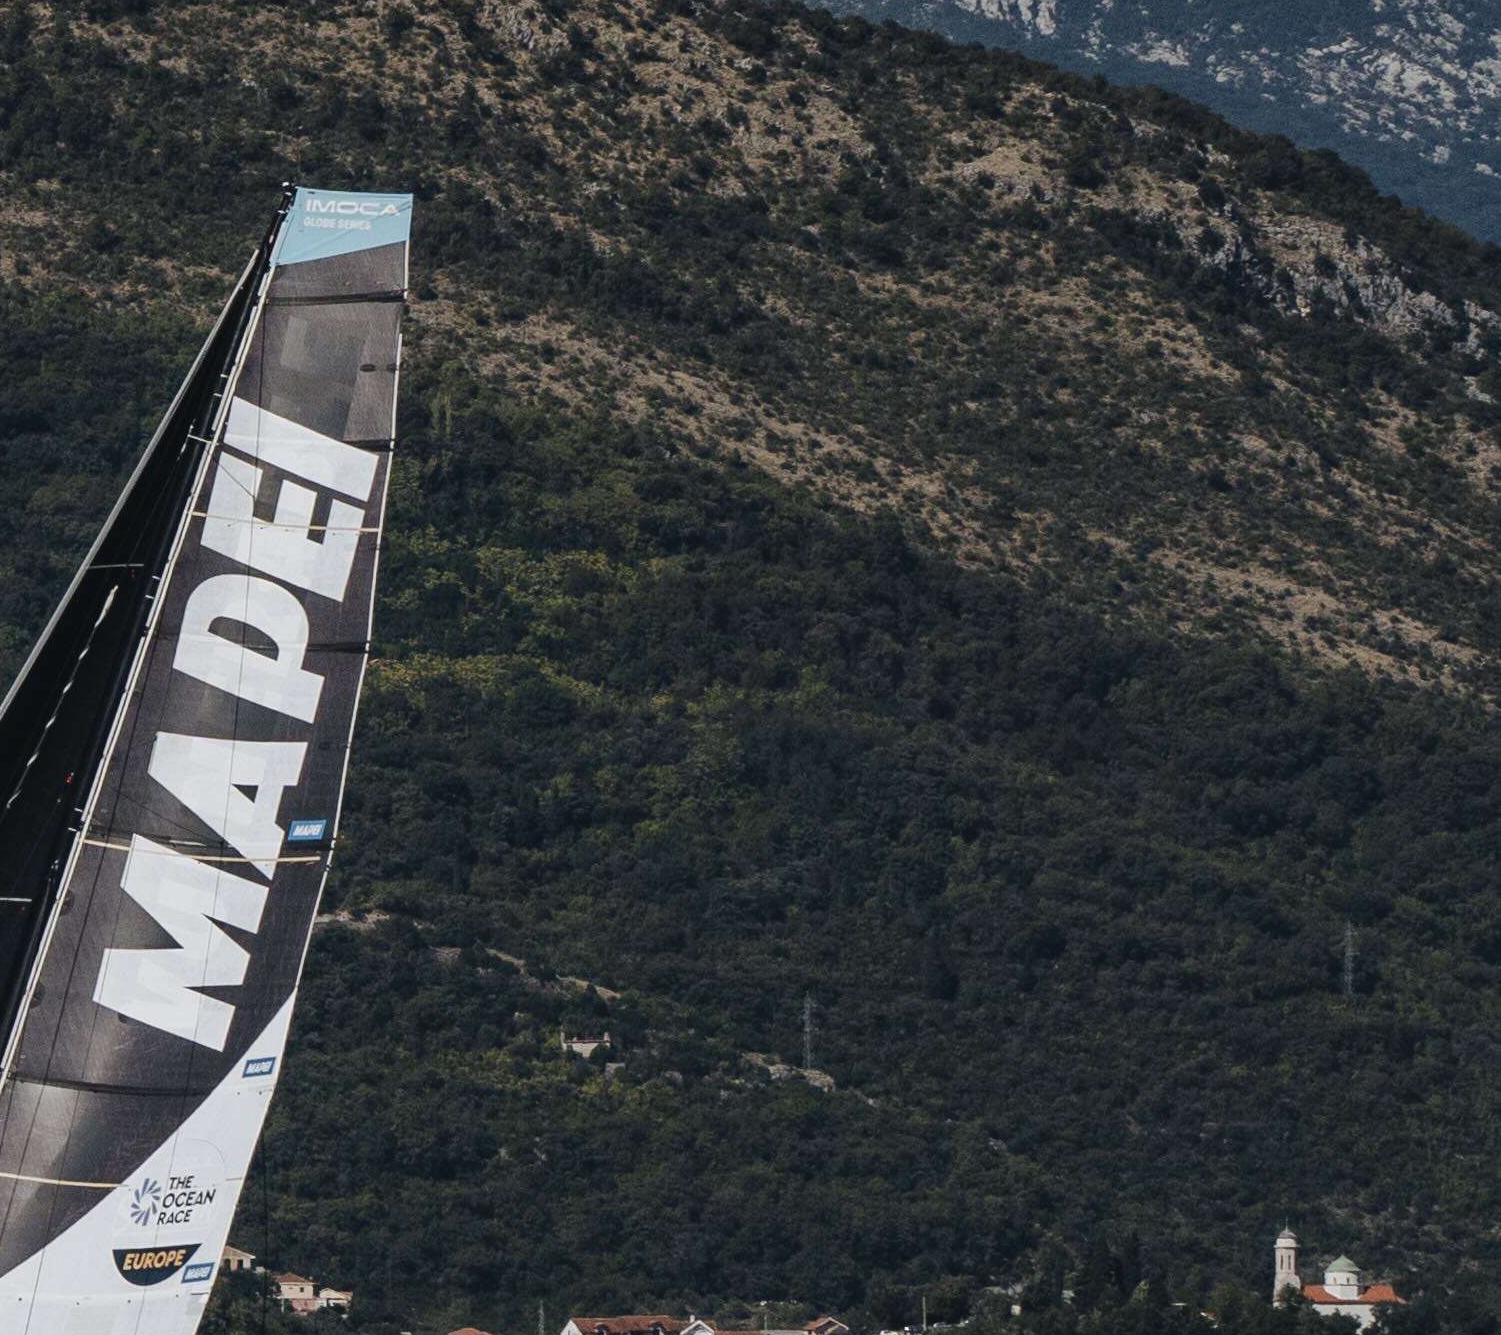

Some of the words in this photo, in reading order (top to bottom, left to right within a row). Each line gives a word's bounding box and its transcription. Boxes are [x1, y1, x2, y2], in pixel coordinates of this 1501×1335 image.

[306, 199, 400, 216] IMOCA
[304, 217, 335, 228] GLOBE
[93, 396, 380, 1052] MAPEI
[169, 1176, 194, 1189] THE
[162, 1189, 216, 1208] OCEAN
[156, 1209, 192, 1225] RACE
[123, 1250, 186, 1270] EUROPE
